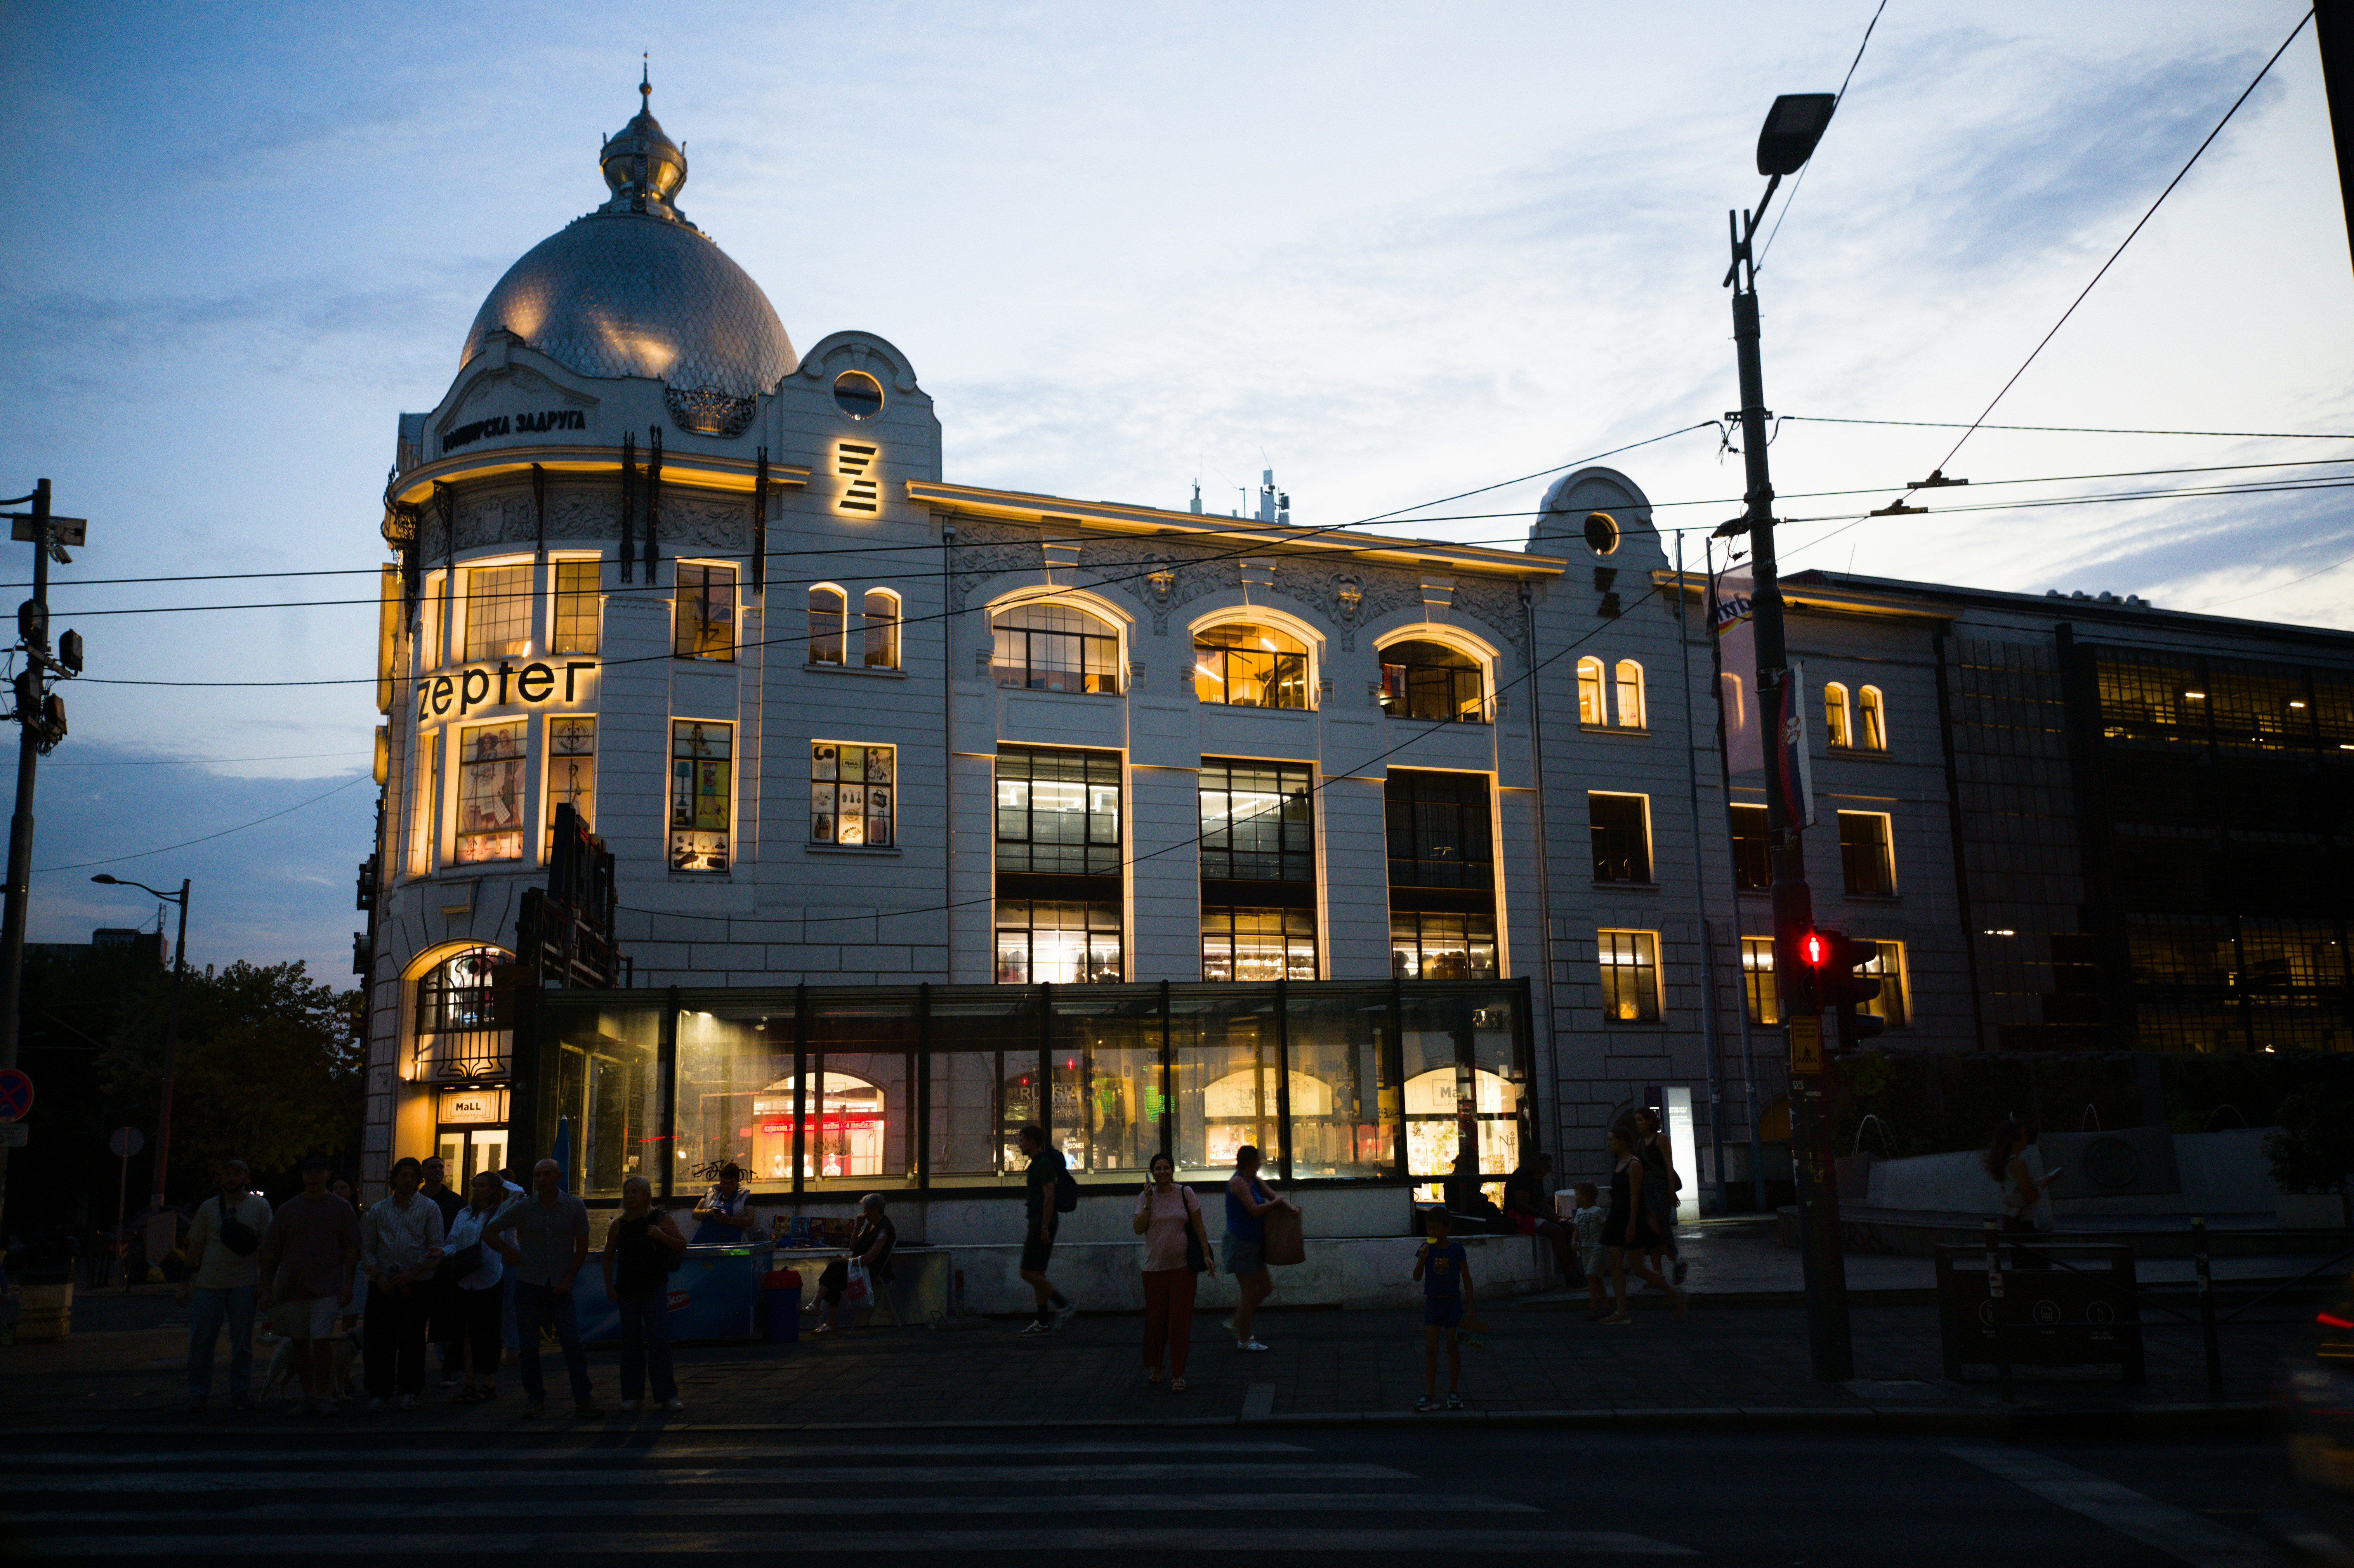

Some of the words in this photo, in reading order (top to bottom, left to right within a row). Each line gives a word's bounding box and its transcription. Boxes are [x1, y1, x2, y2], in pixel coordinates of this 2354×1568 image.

[515, 410, 585, 433] ЗАДРУГА
[417, 661, 597, 723] zepter
[1020, 1086, 1078, 1101] RUSIA
[456, 1102, 481, 1111] MaLL
